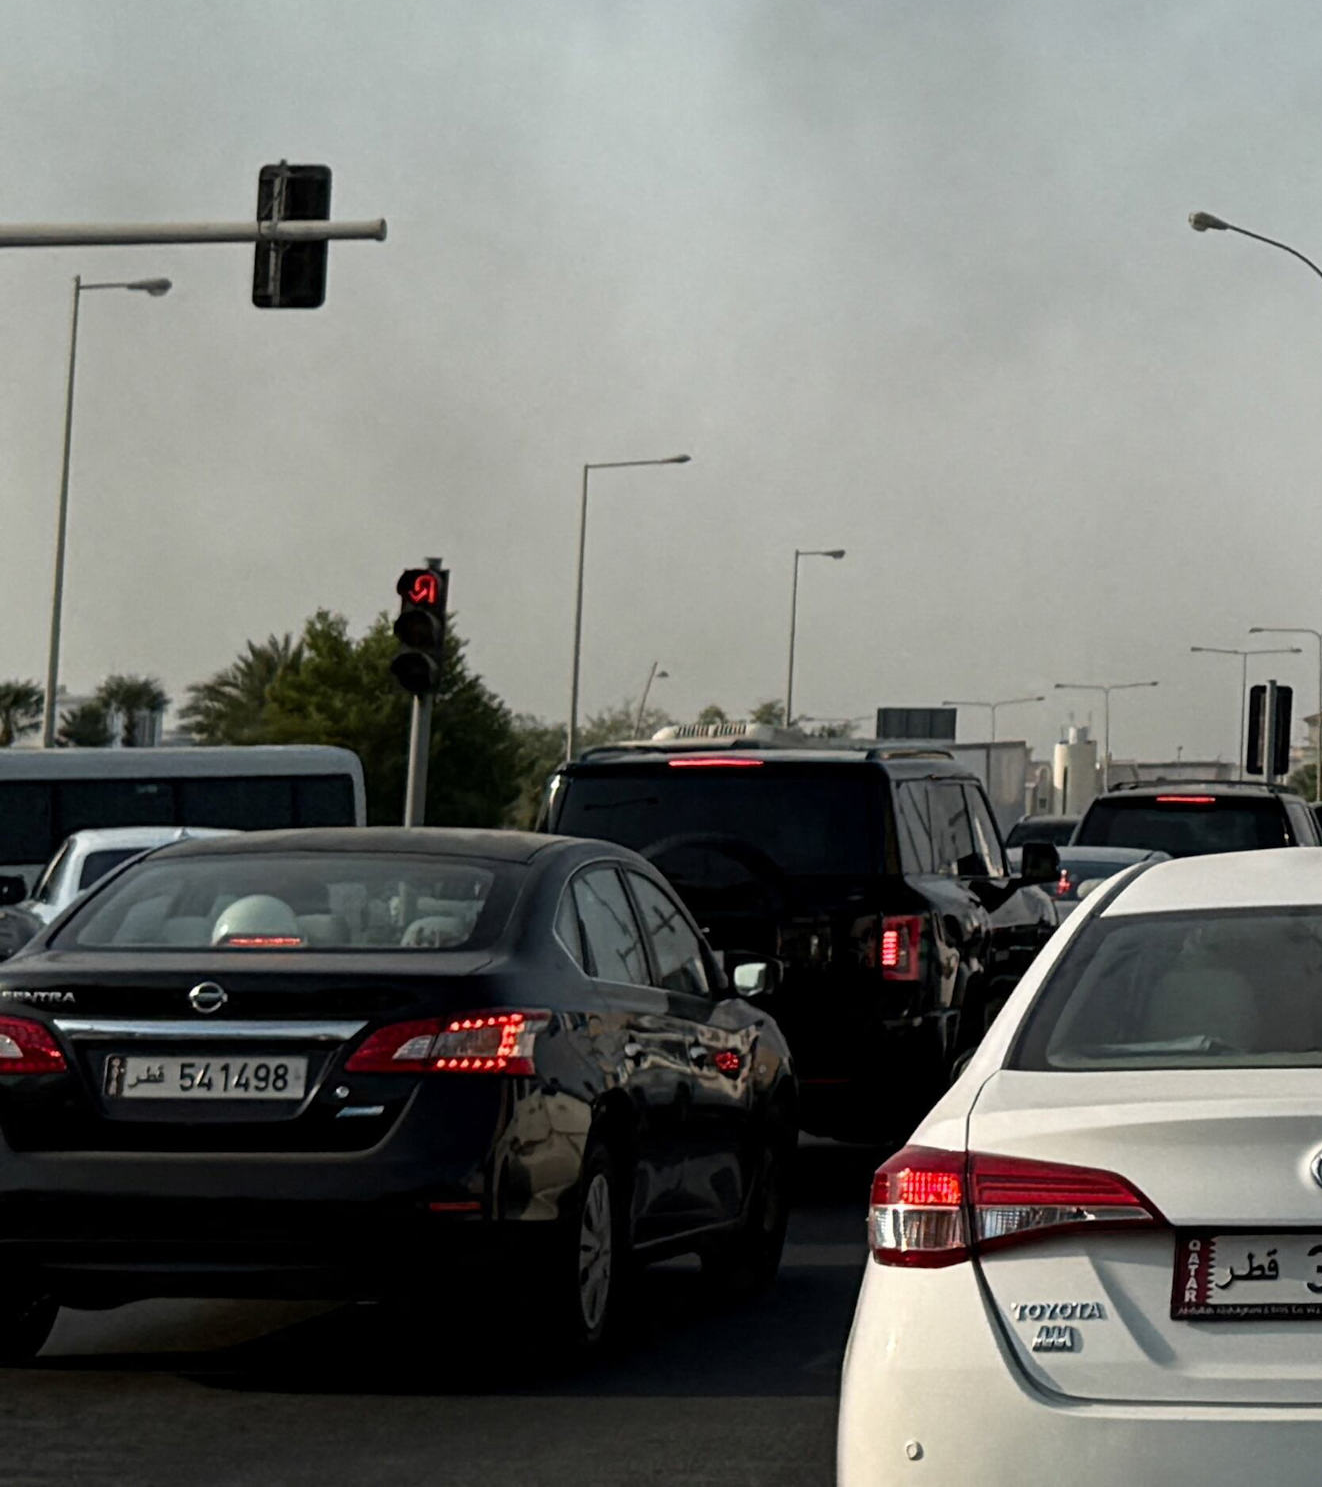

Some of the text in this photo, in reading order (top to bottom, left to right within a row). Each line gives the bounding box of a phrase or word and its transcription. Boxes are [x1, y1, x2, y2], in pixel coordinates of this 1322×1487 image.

[128, 1064, 165, 1089] قطر
[179, 1063, 289, 1093] 541498
[1184, 1239, 1201, 1303] QATAR
[1215, 1249, 1279, 1289] قطر
[1010, 1301, 1106, 1321] TOYOTA
